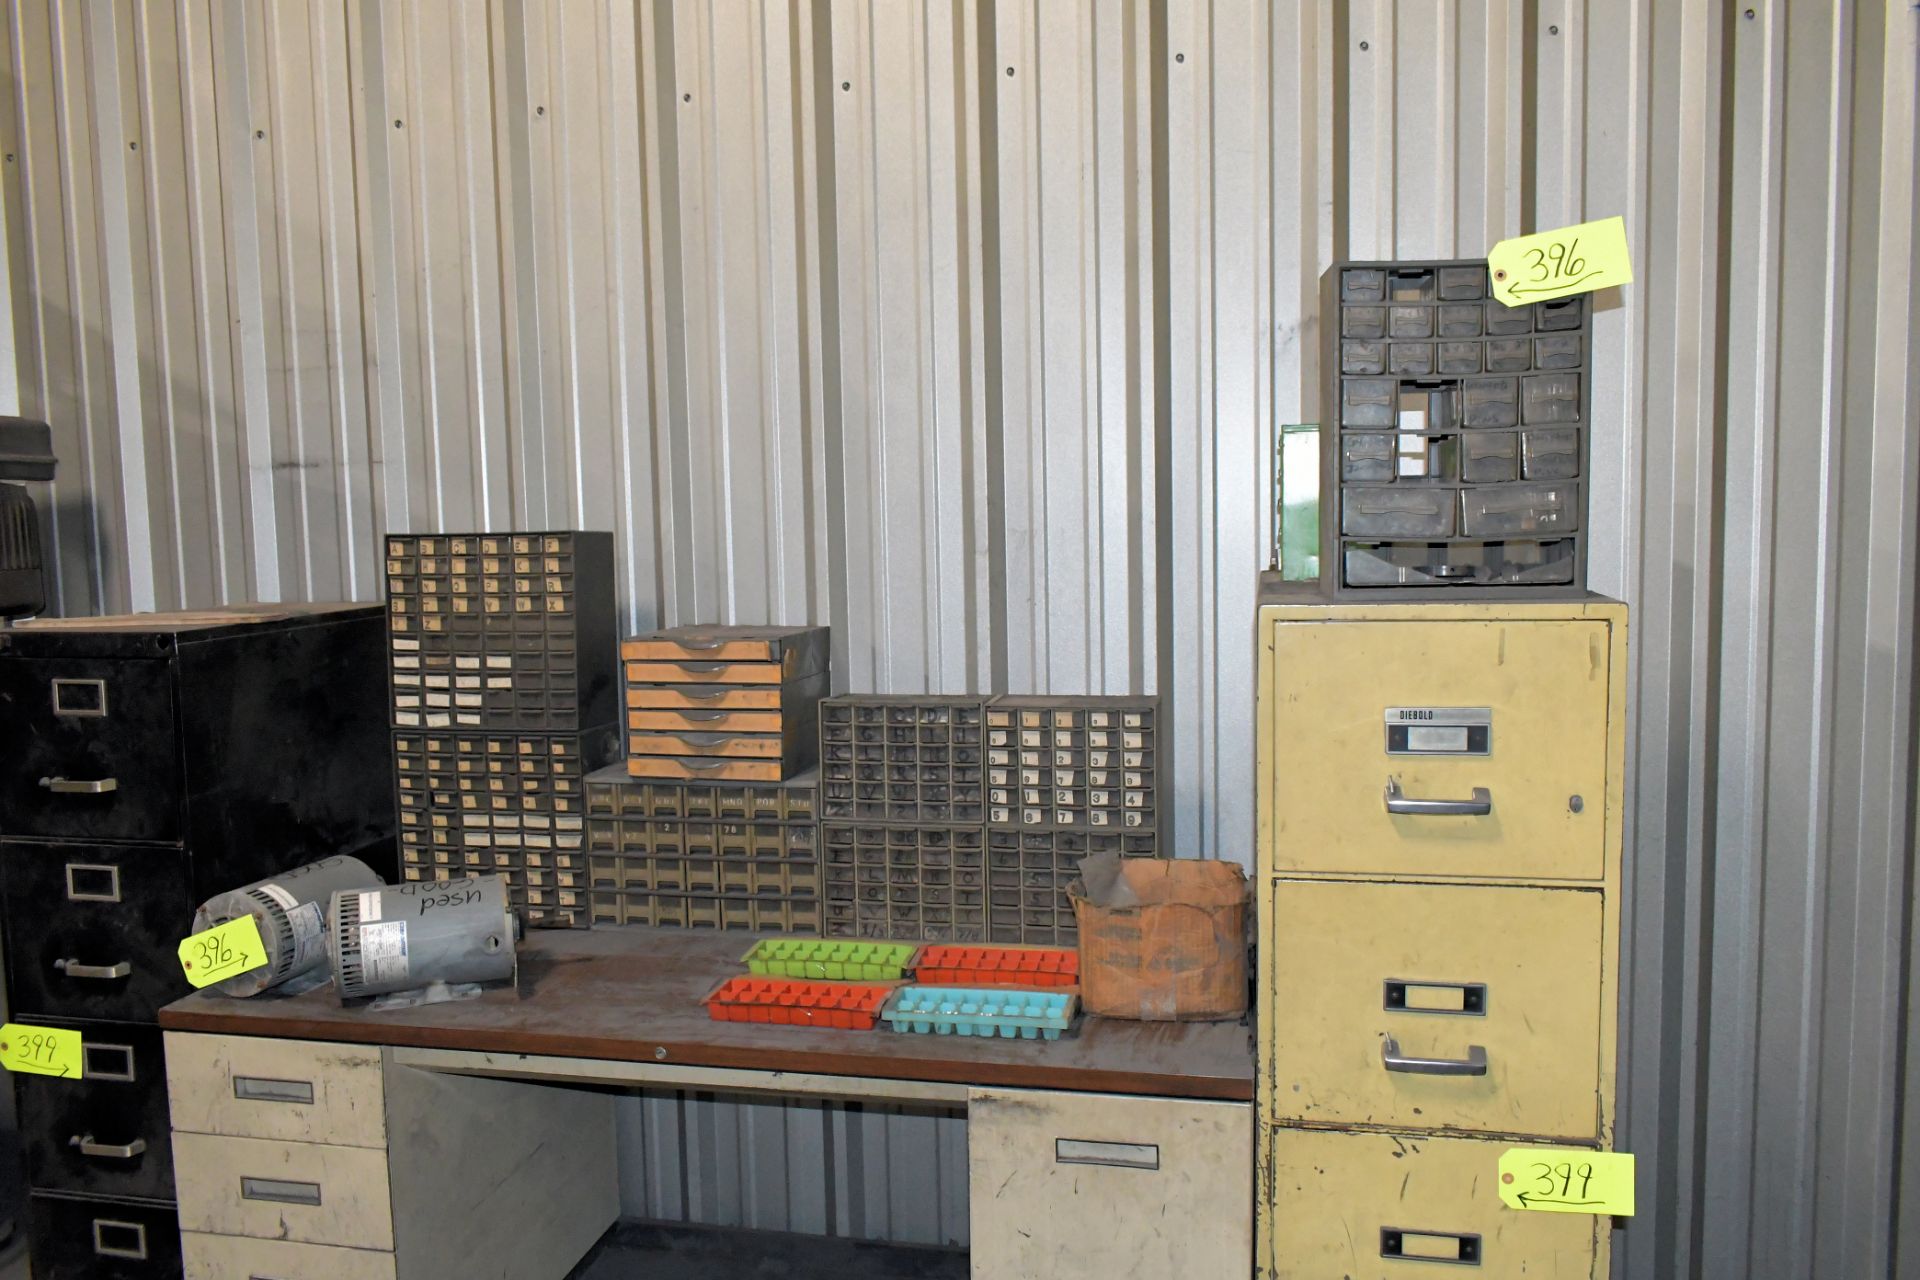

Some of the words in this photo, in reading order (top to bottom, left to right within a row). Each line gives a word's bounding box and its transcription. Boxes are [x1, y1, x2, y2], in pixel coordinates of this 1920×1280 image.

[1522, 237, 1586, 283] 396
[1399, 710, 1434, 721] DIEBOLD
[419, 889, 482, 916] used
[193, 931, 233, 970] 396
[17, 1033, 58, 1064] 399
[1530, 1161, 1594, 1200] 399
